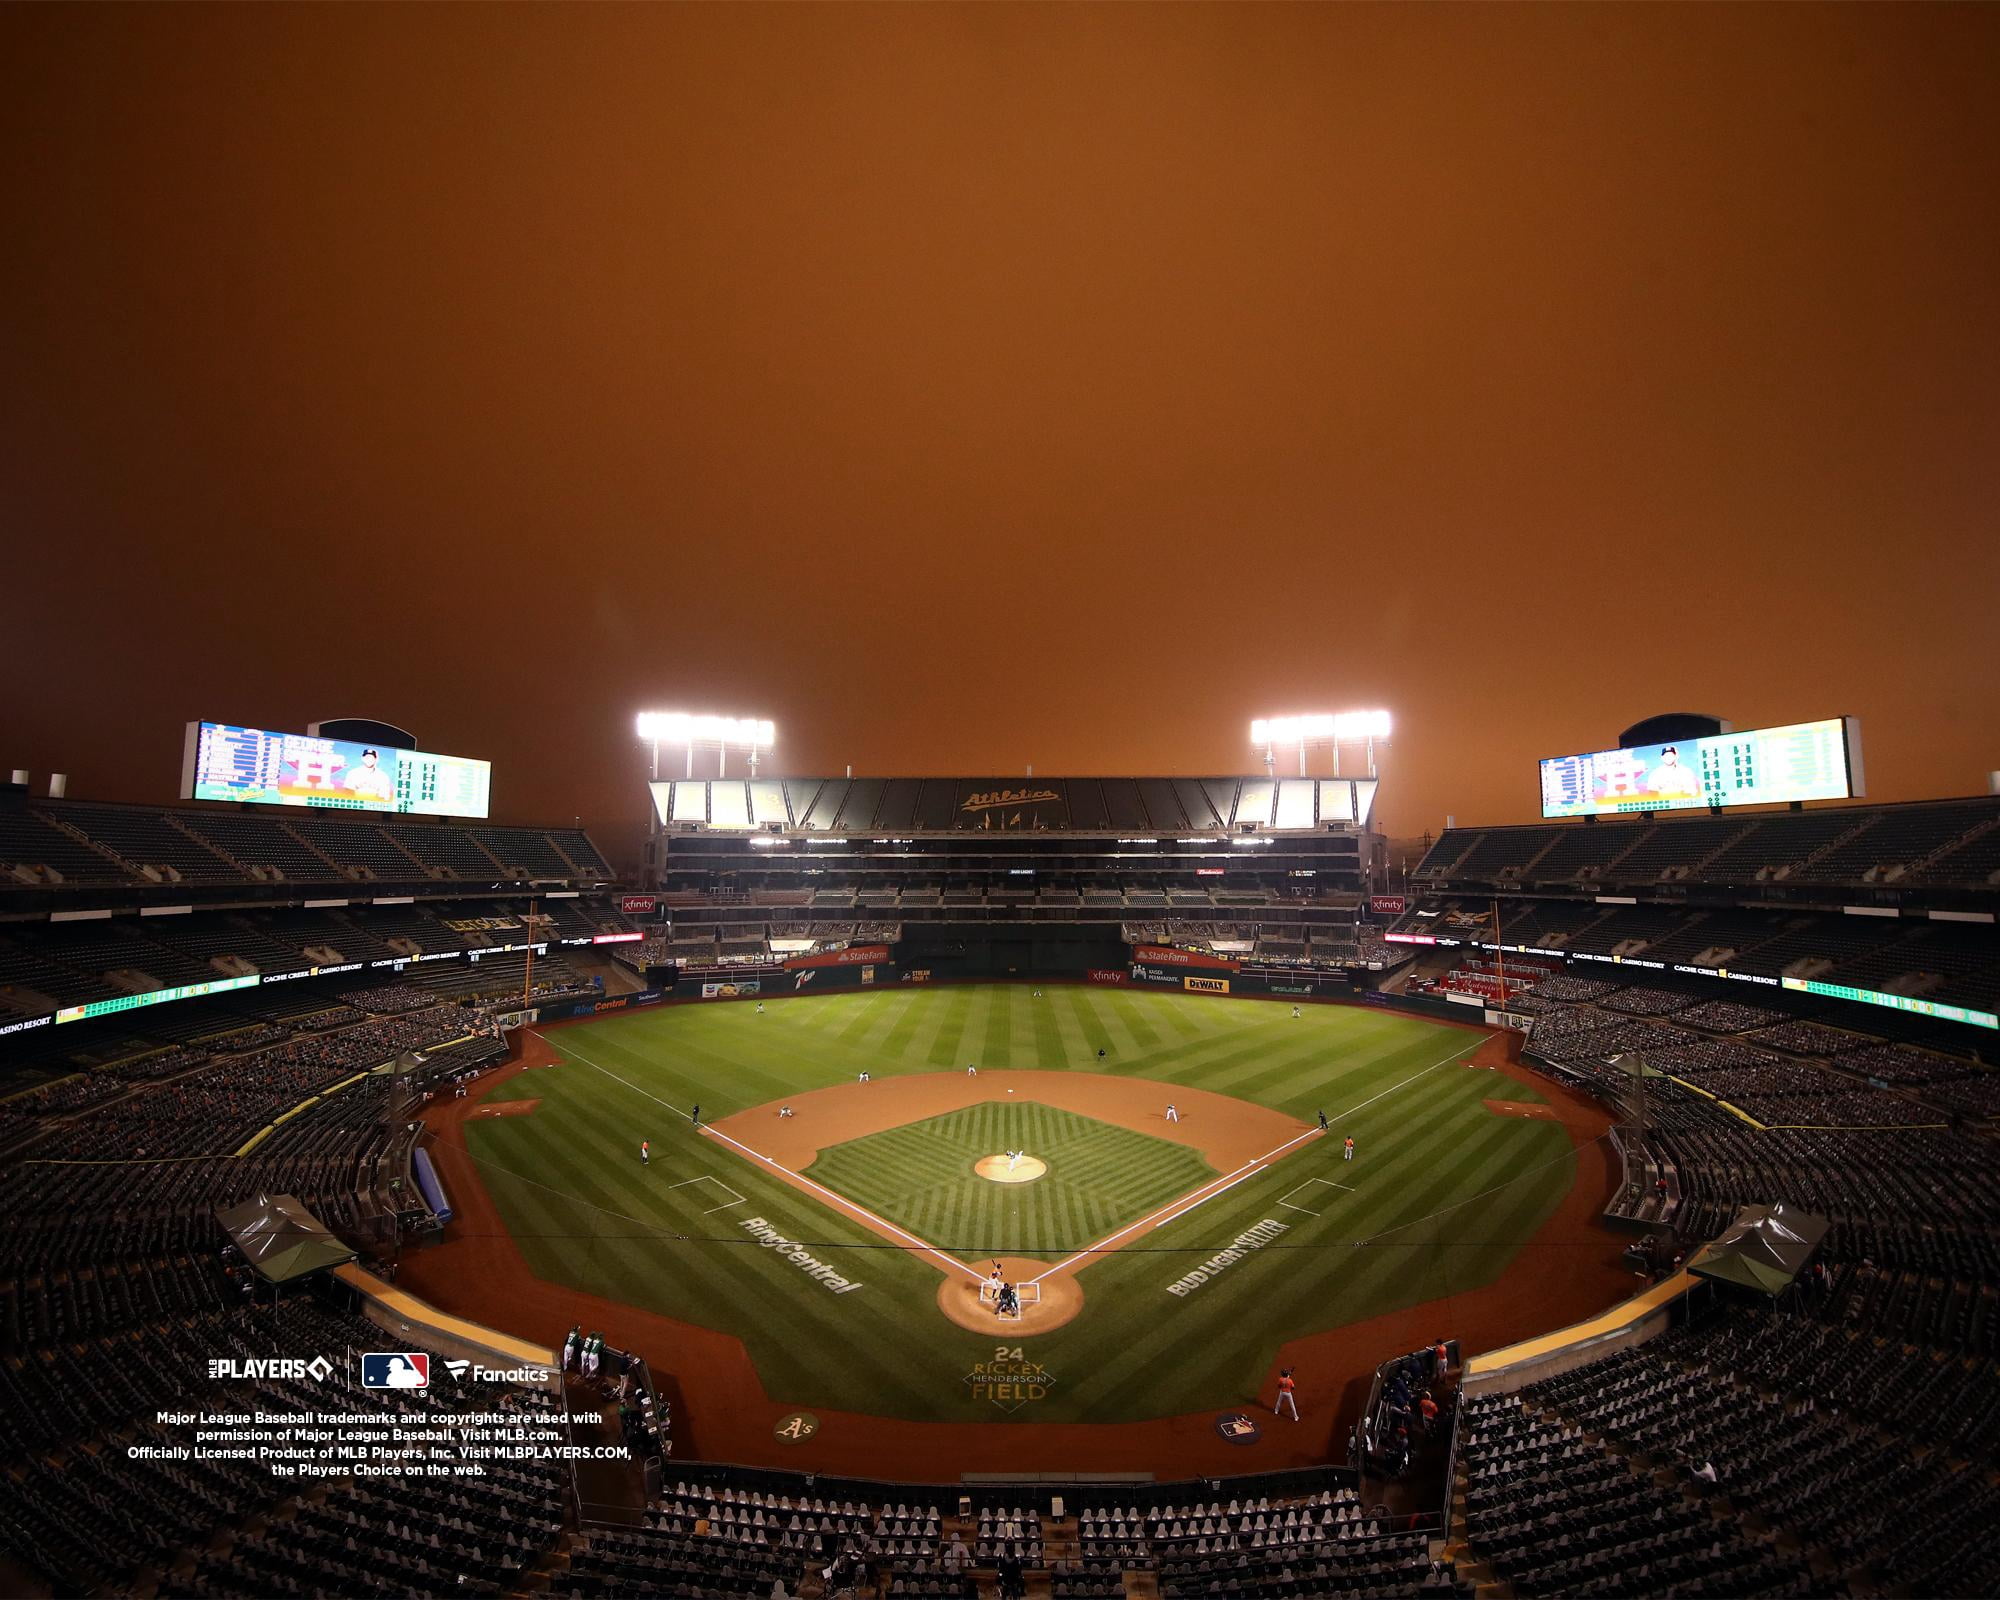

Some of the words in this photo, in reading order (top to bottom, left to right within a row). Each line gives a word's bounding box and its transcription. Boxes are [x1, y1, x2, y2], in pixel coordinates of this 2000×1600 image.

[960, 790, 1062, 811] Athletics
[625, 900, 653, 910] xfinity
[1373, 900, 1402, 910] xfinity
[1093, 970, 1121, 982] xfinity
[0, 1022, 23, 1035] ASINO
[1166, 1271, 1209, 1297] BUD
[1197, 1246, 1249, 1276] LIGHT
[994, 1346, 1024, 1361] 24
[974, 1363, 1044, 1375] RICKEY
[972, 1375, 1047, 1383] HENDERSON
[972, 1383, 1046, 1400] FIELD
[776, 1418, 814, 1439] A's
